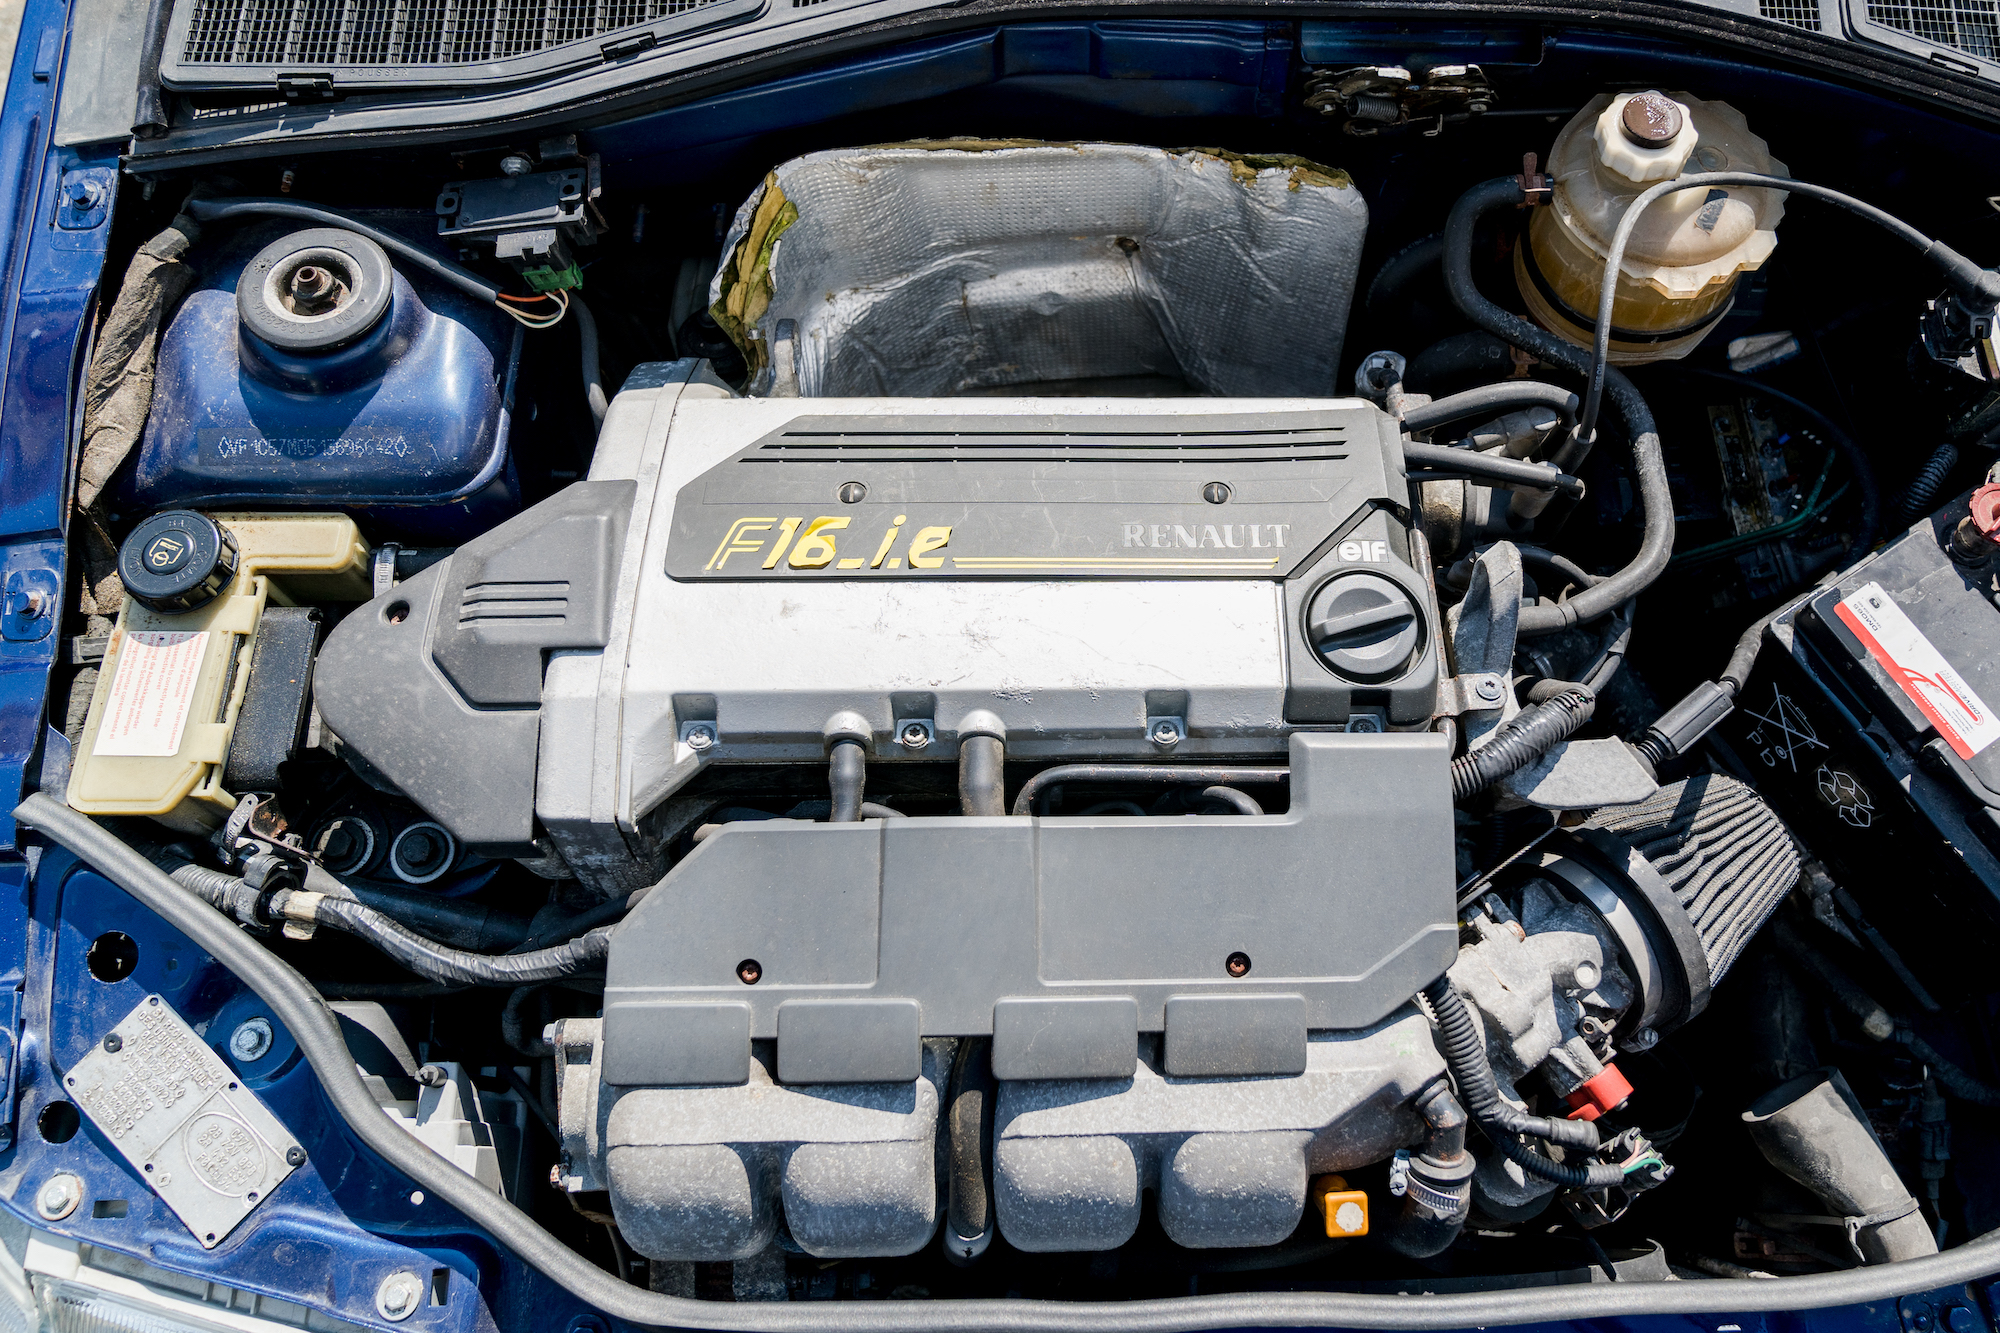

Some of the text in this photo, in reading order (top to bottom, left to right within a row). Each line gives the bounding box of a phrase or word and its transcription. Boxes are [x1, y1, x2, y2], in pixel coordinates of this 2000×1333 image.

[348, 67, 408, 77] POUSSER
[1122, 523, 1291, 548] RENAULT
[1338, 542, 1387, 562] elf
[123, 632, 136, 658] protector
[169, 643, 181, 669] essential
[181, 639, 195, 668] protecteur
[191, 633, 204, 660] Remonter
[122, 658, 129, 666] de
[141, 659, 148, 669] am
[159, 645, 172, 674] protective
[122, 669, 133, 690] montar
[130, 669, 146, 706] Scheinwerfer
[131, 632, 164, 729] Ubedingt die Abdeckkappe wieder
[155, 674, 164, 690] cover
[159, 675, 172, 701] correctly
[1939, 669, 1980, 715] DRIVEMASTER
[110, 690, 127, 732] correctamente
[121, 706, 135, 736] anbringen
[152, 717, 160, 727] the
[155, 701, 164, 717] re-fit
[166, 710, 182, 750] correctement
[136, 1009, 214, 1092] DES USINES RENAULT
[151, 1006, 223, 1083] SA REGIE NATIONALE
[127, 1057, 170, 1103] 13696642
